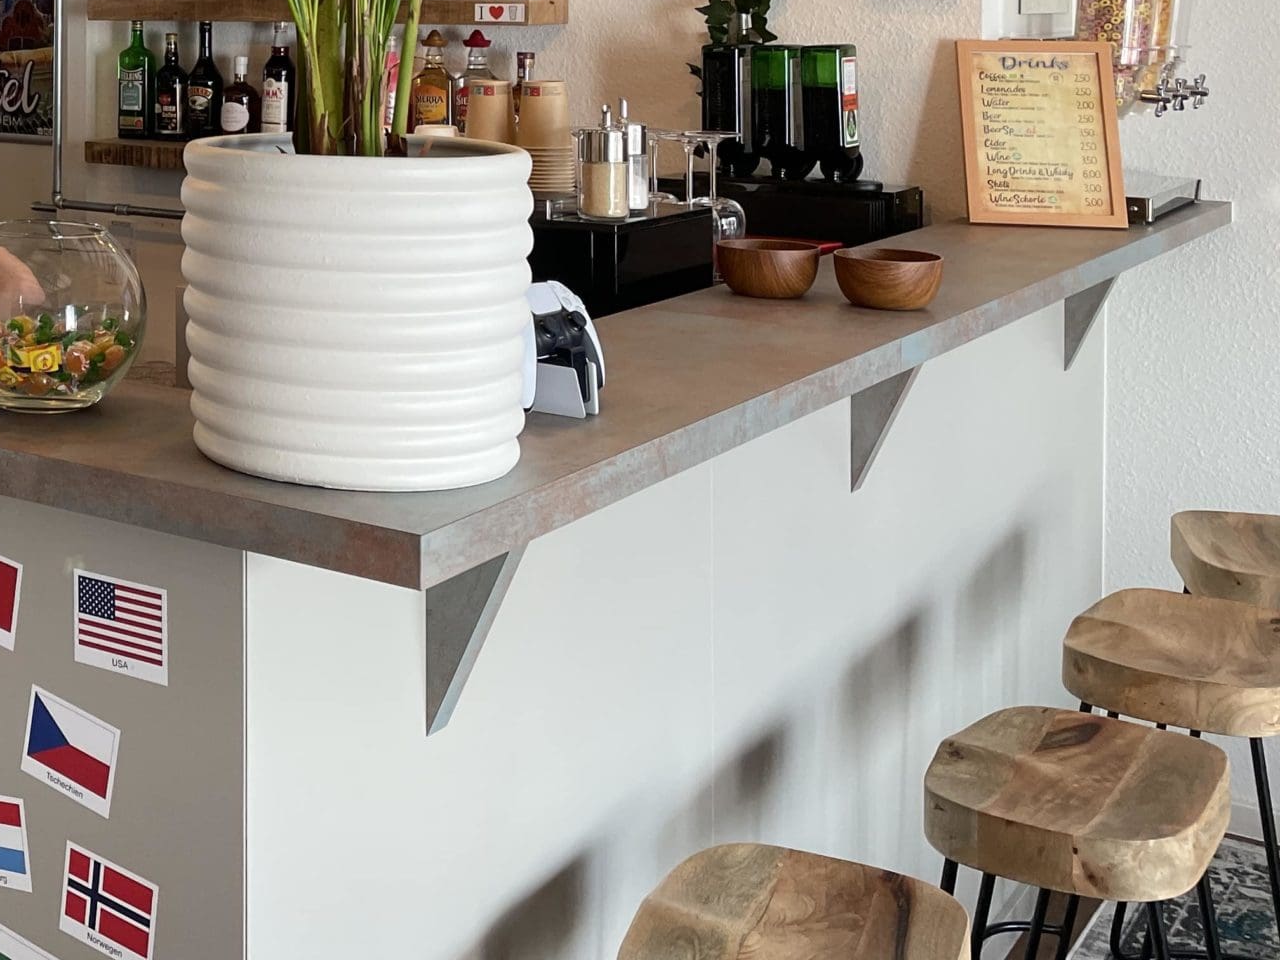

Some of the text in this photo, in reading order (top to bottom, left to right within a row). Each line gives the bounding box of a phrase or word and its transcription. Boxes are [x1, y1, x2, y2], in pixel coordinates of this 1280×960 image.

[478, 5, 484, 20] I
[999, 56, 1070, 70] Drinks
[416, 95, 444, 104] SIERRA
[982, 98, 1010, 107] Water
[982, 112, 1001, 120] Beer
[984, 138, 1007, 147] Cider
[986, 151, 1011, 161] Wine
[111, 658, 129, 670] USA
[46, 771, 84, 799] Tschechien
[87, 932, 123, 958] Norwegen
